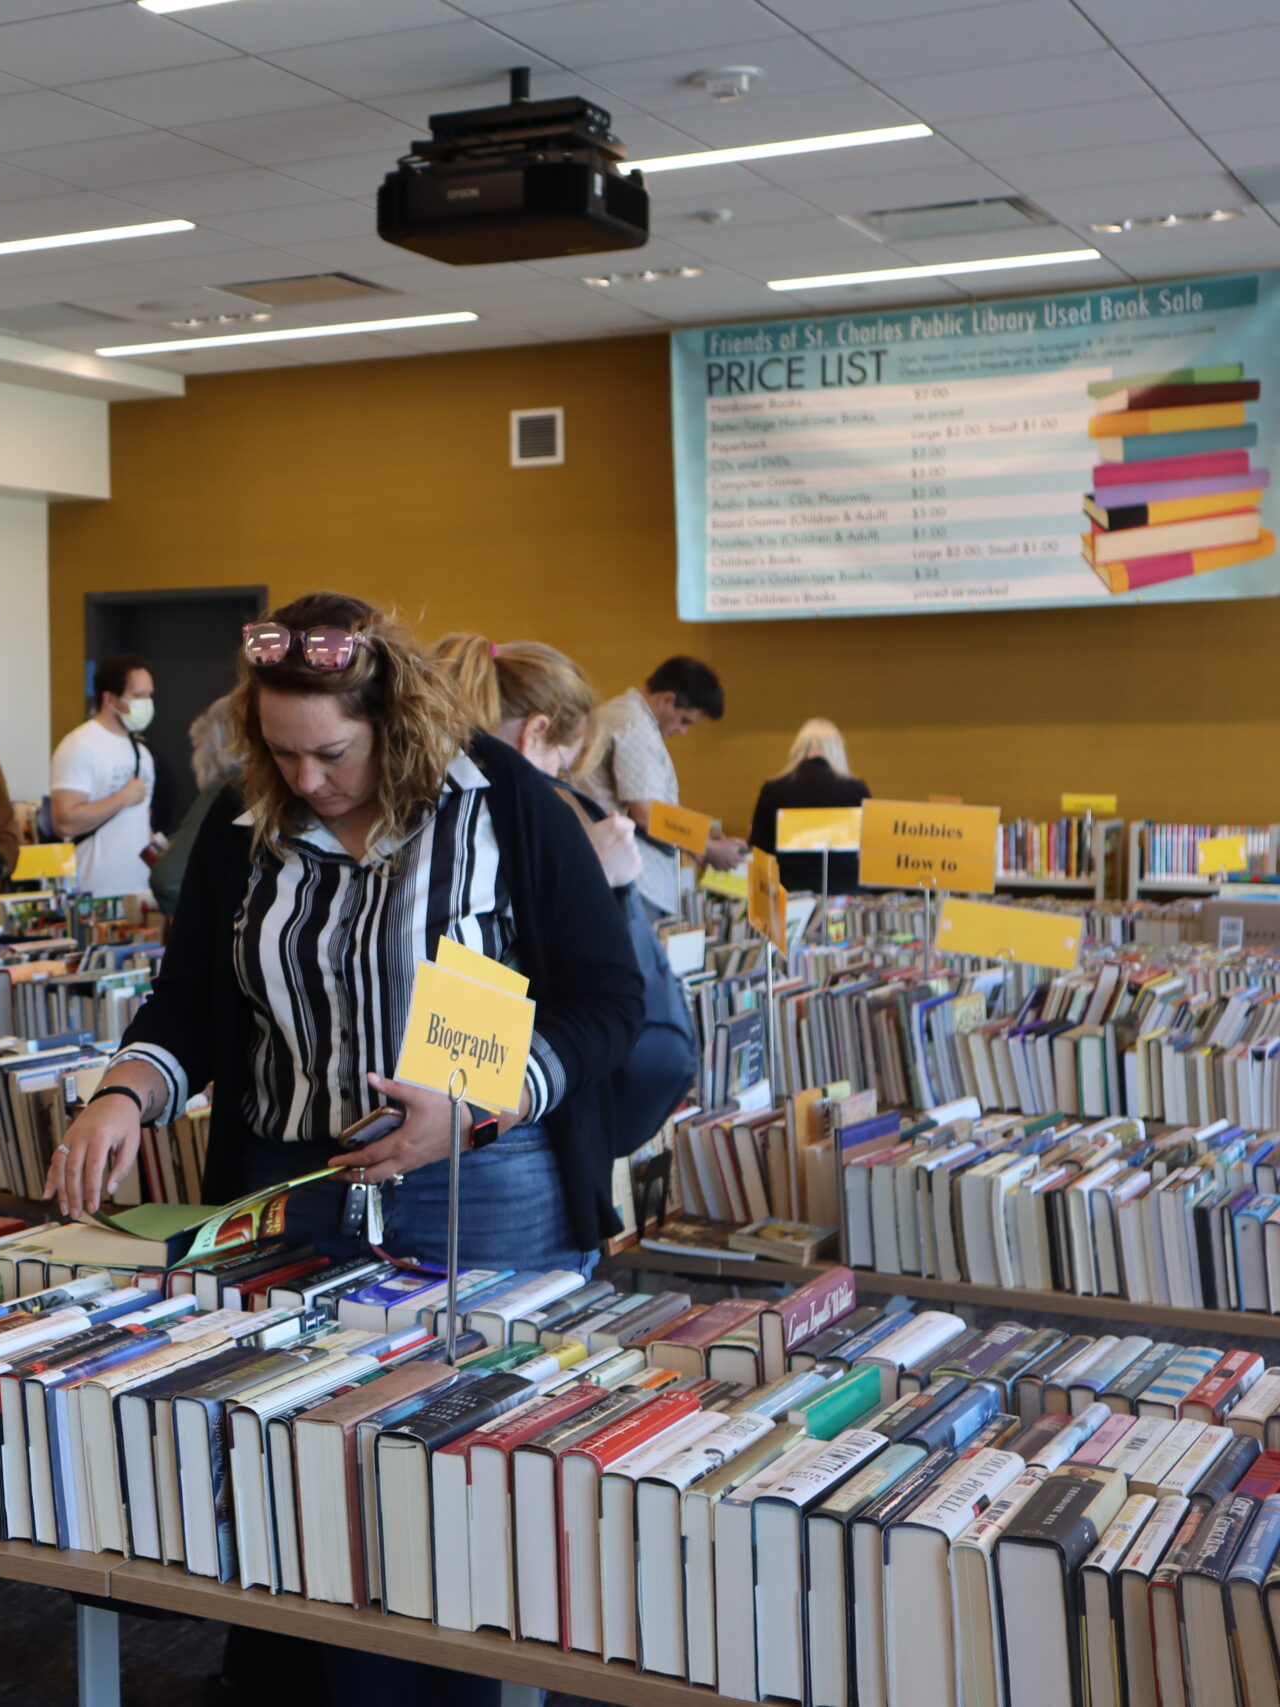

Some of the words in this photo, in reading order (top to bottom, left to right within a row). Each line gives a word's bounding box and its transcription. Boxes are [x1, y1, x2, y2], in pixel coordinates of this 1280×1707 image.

[711, 329, 773, 354] Friends
[779, 326, 797, 350] of
[805, 324, 829, 348] St.
[837, 319, 902, 345] Charles
[911, 312, 963, 338] Public
[972, 307, 1035, 336] Library
[1044, 299, 1091, 327] Used
[1100, 289, 1149, 322] Book
[1159, 286, 1204, 314] Sale
[707, 356, 806, 394] PRICE
[821, 350, 888, 388] LIST
[893, 820, 963, 839] Hobbies
[896, 854, 933, 870] How
[941, 858, 958, 872] to
[426, 1013, 509, 1074] Biography
[975, 1452, 1014, 1481] COLIN
[936, 1477, 985, 1514] POWELL
